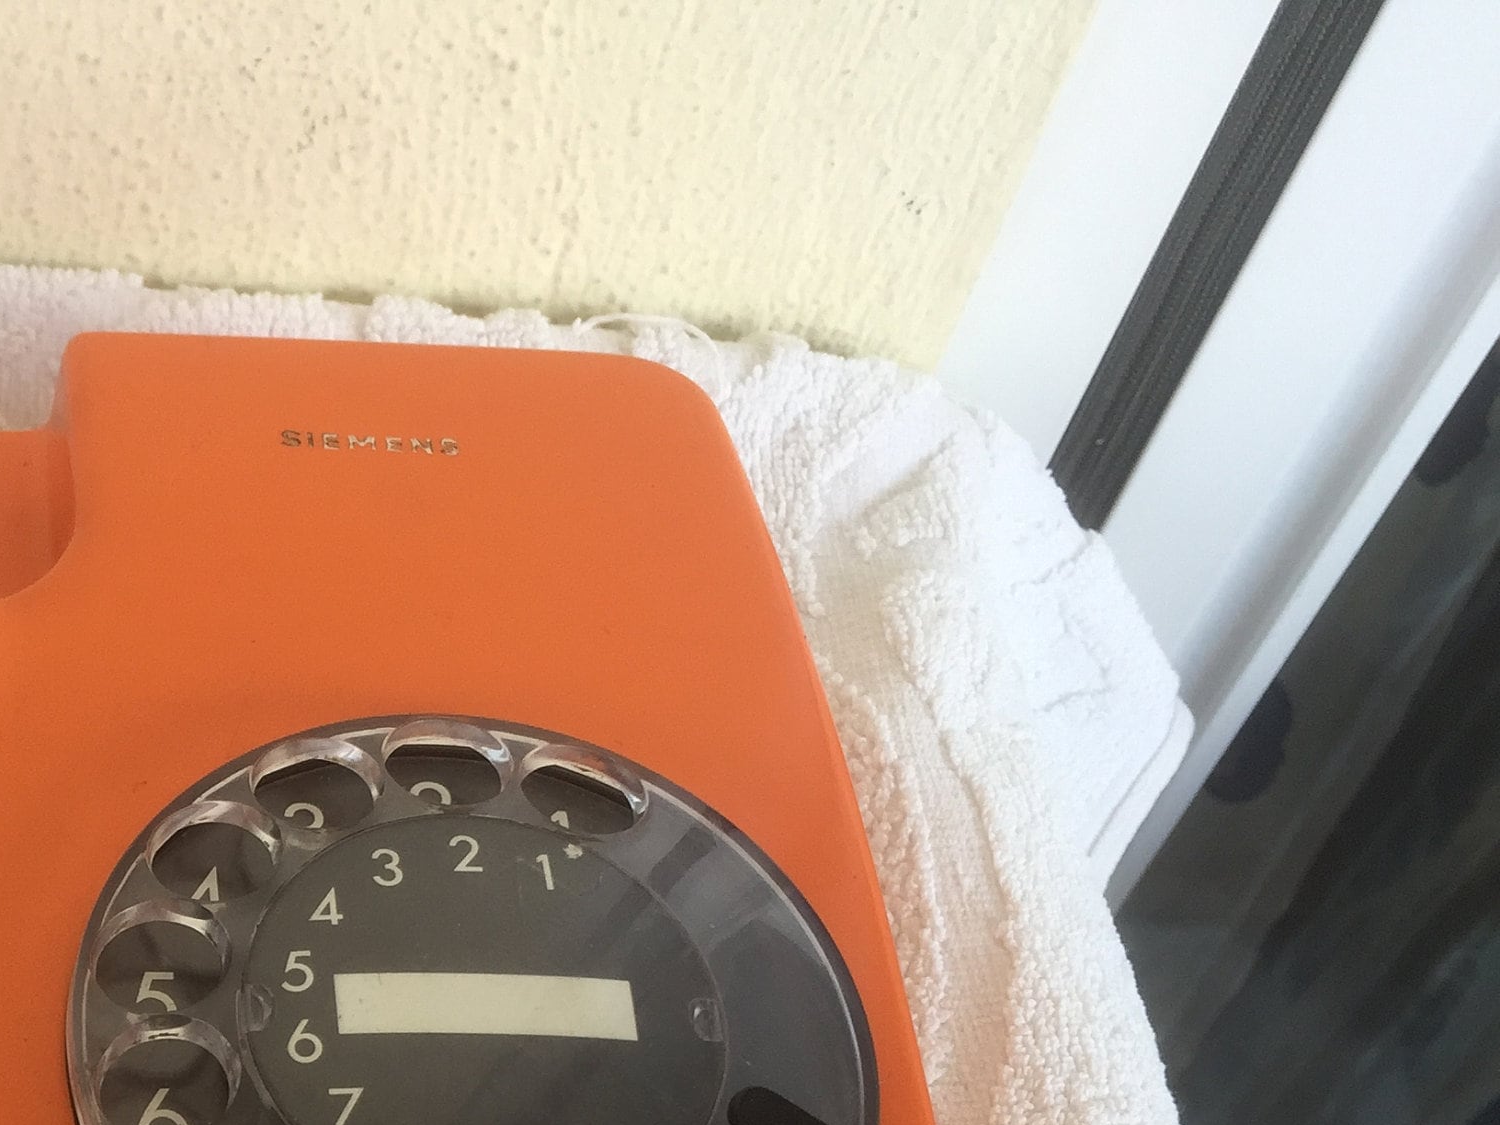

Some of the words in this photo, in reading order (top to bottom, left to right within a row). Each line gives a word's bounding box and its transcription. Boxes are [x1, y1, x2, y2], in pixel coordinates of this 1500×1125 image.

[281, 430, 460, 456] SIEMENS
[371, 848, 404, 887] 3
[449, 834, 484, 873] 2
[535, 854, 555, 891] 1
[308, 887, 344, 926] 4
[281, 950, 315, 993] 5
[287, 1018, 323, 1064] 6
